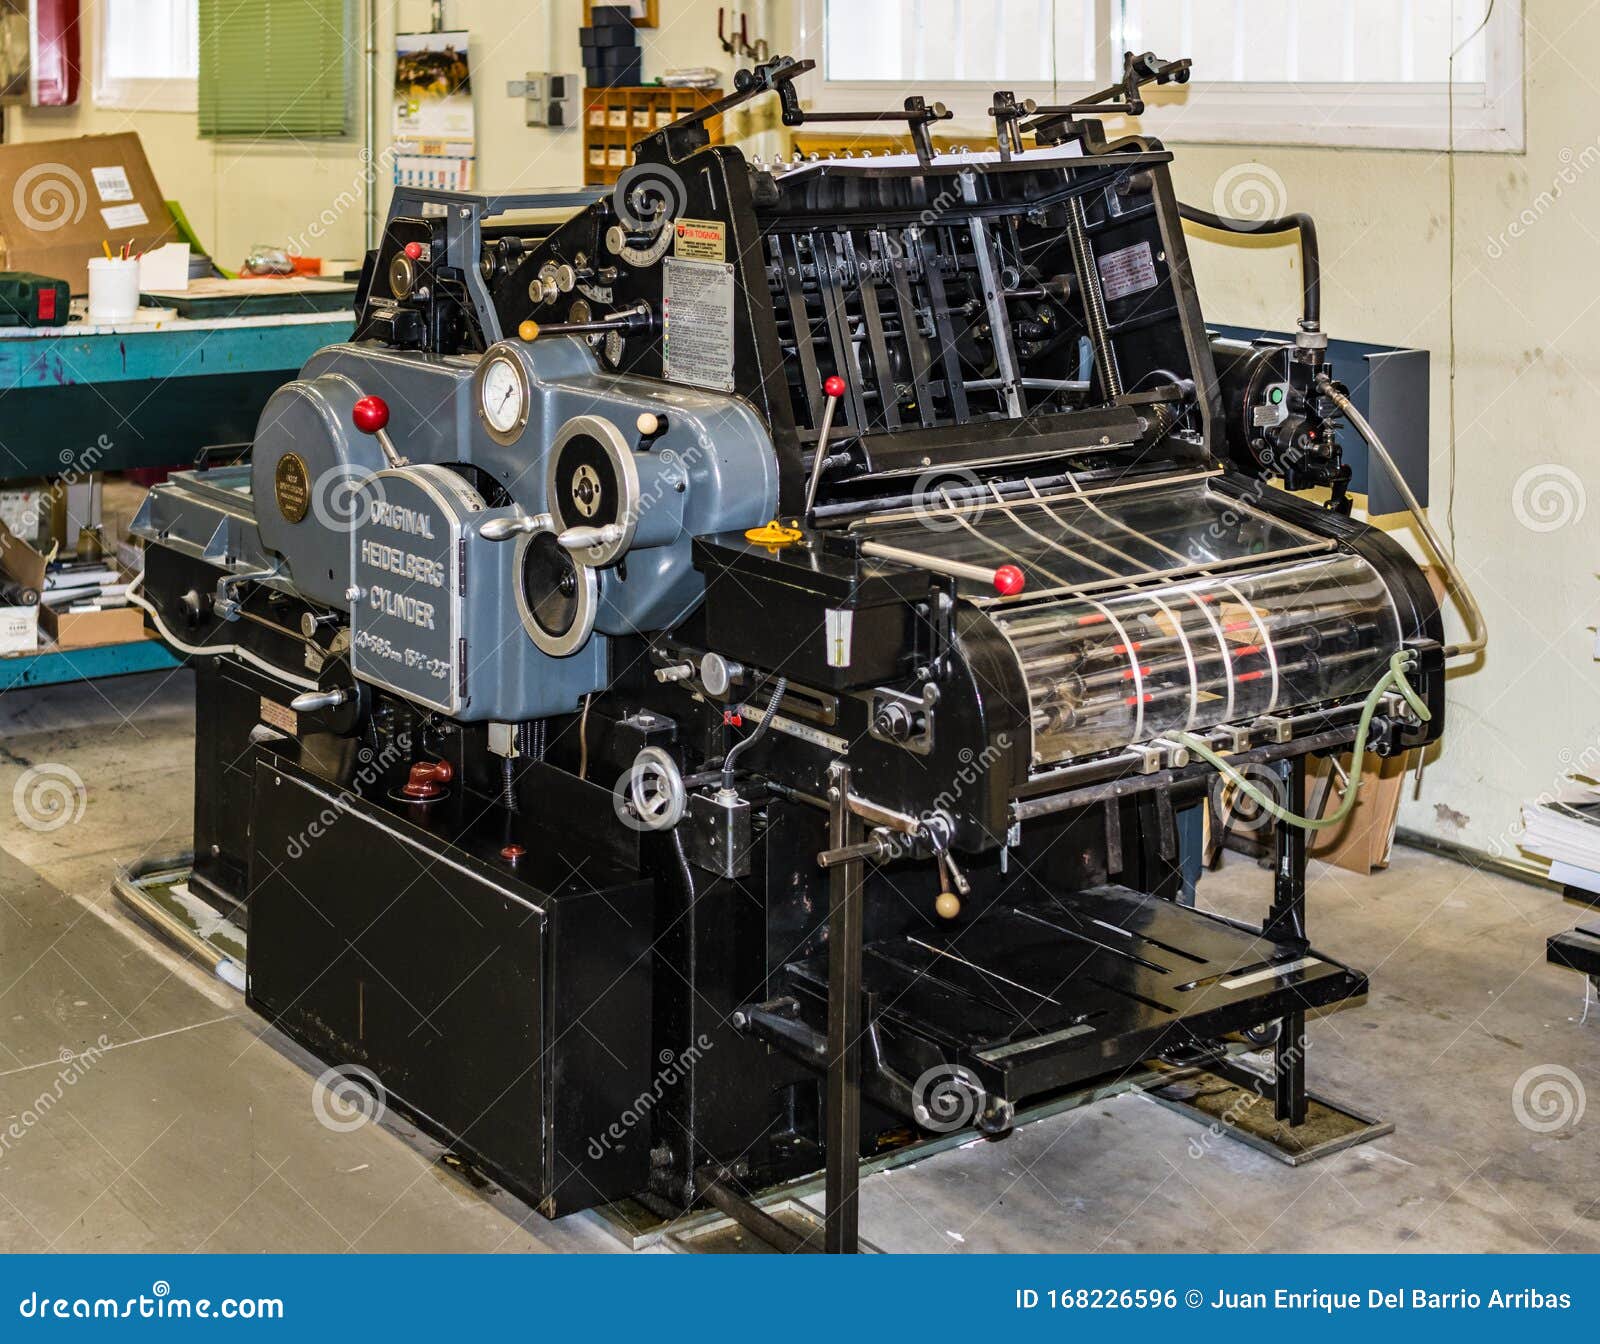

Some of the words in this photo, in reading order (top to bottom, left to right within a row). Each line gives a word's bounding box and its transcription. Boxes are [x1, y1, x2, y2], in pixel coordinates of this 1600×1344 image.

[370, 500, 435, 540] ORIGINAL
[361, 538, 445, 588] HEIDELBERG
[370, 585, 435, 630] CYLINDER
